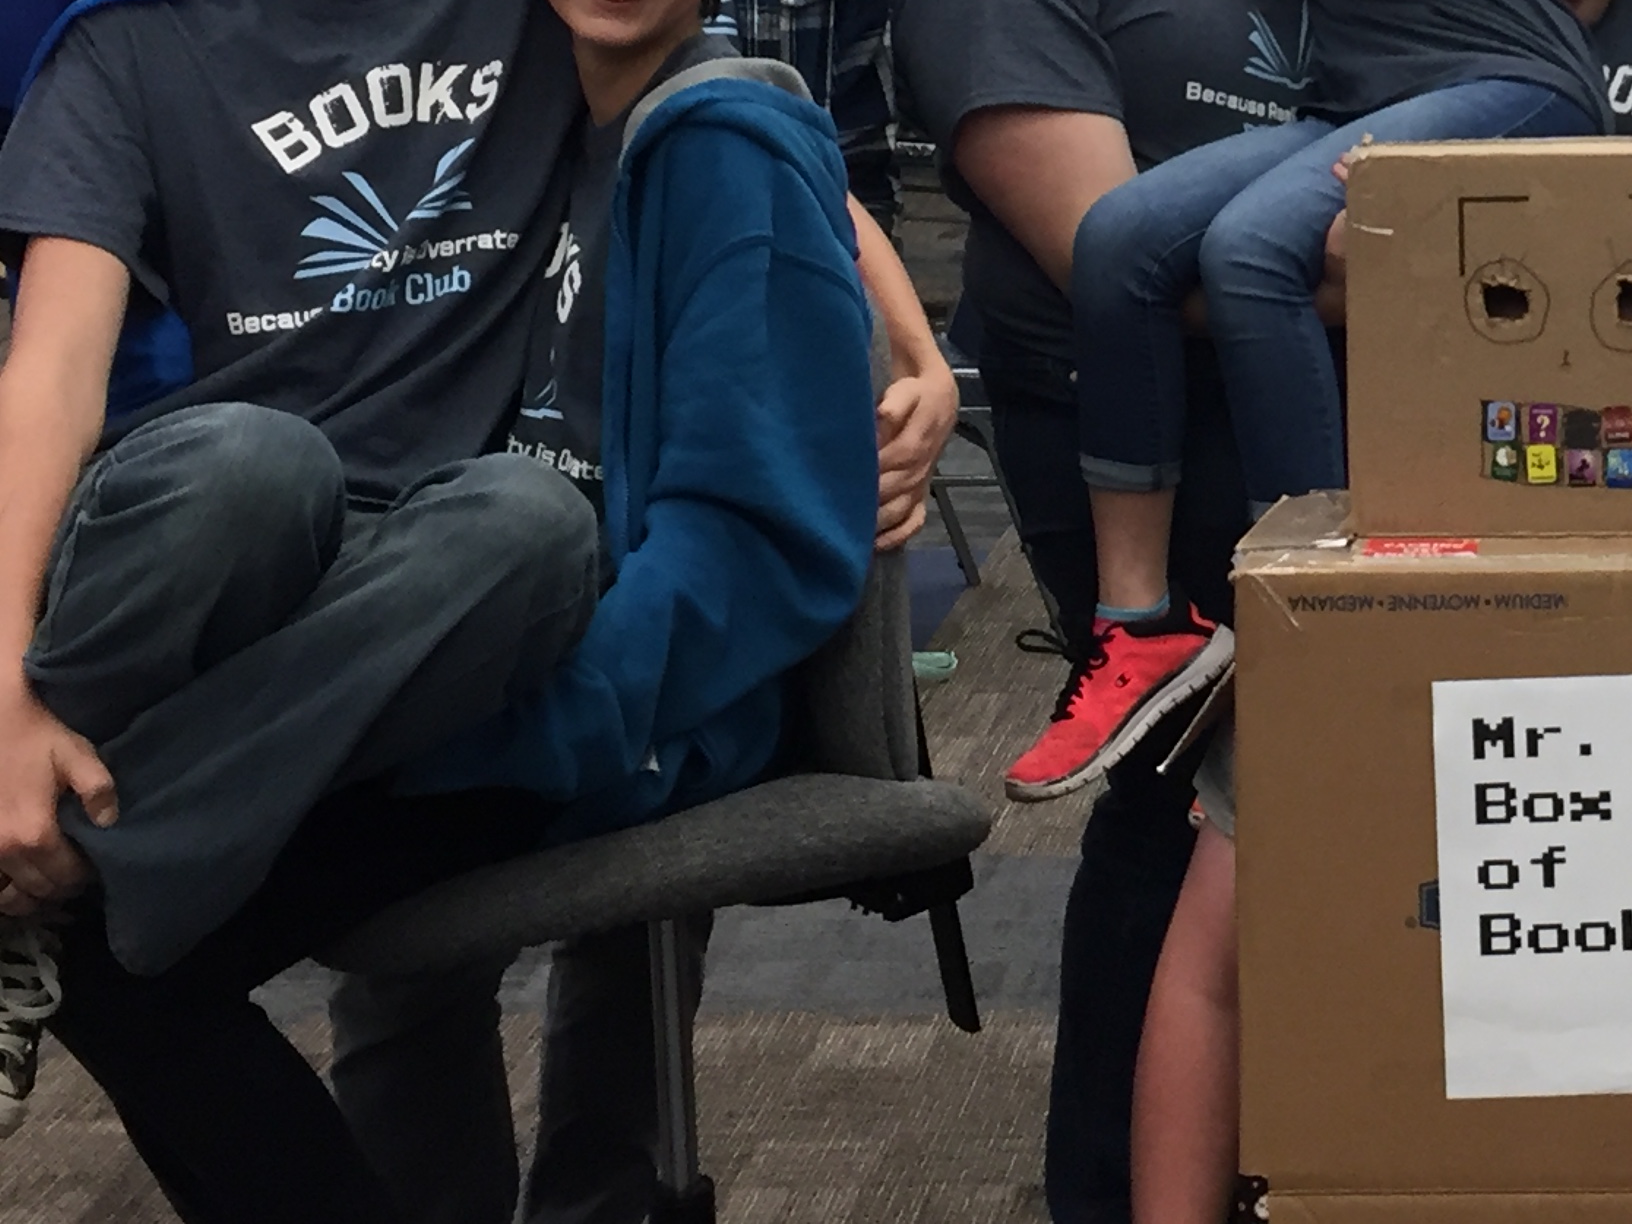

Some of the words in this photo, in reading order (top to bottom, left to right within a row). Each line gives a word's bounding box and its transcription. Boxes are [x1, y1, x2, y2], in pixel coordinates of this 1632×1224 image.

[251, 60, 503, 174] BOOKS
[1185, 80, 1267, 118] Because
[405, 264, 472, 306] Club
[226, 306, 324, 336] Becau
[1287, 594, 1375, 613] MEDIANA
[1387, 593, 1481, 612] MOYENNE
[1494, 592, 1568, 612] MEDIUM
[1471, 716, 1593, 760] Mr.
[1474, 781, 1613, 825] Box
[1477, 845, 1567, 890] of
